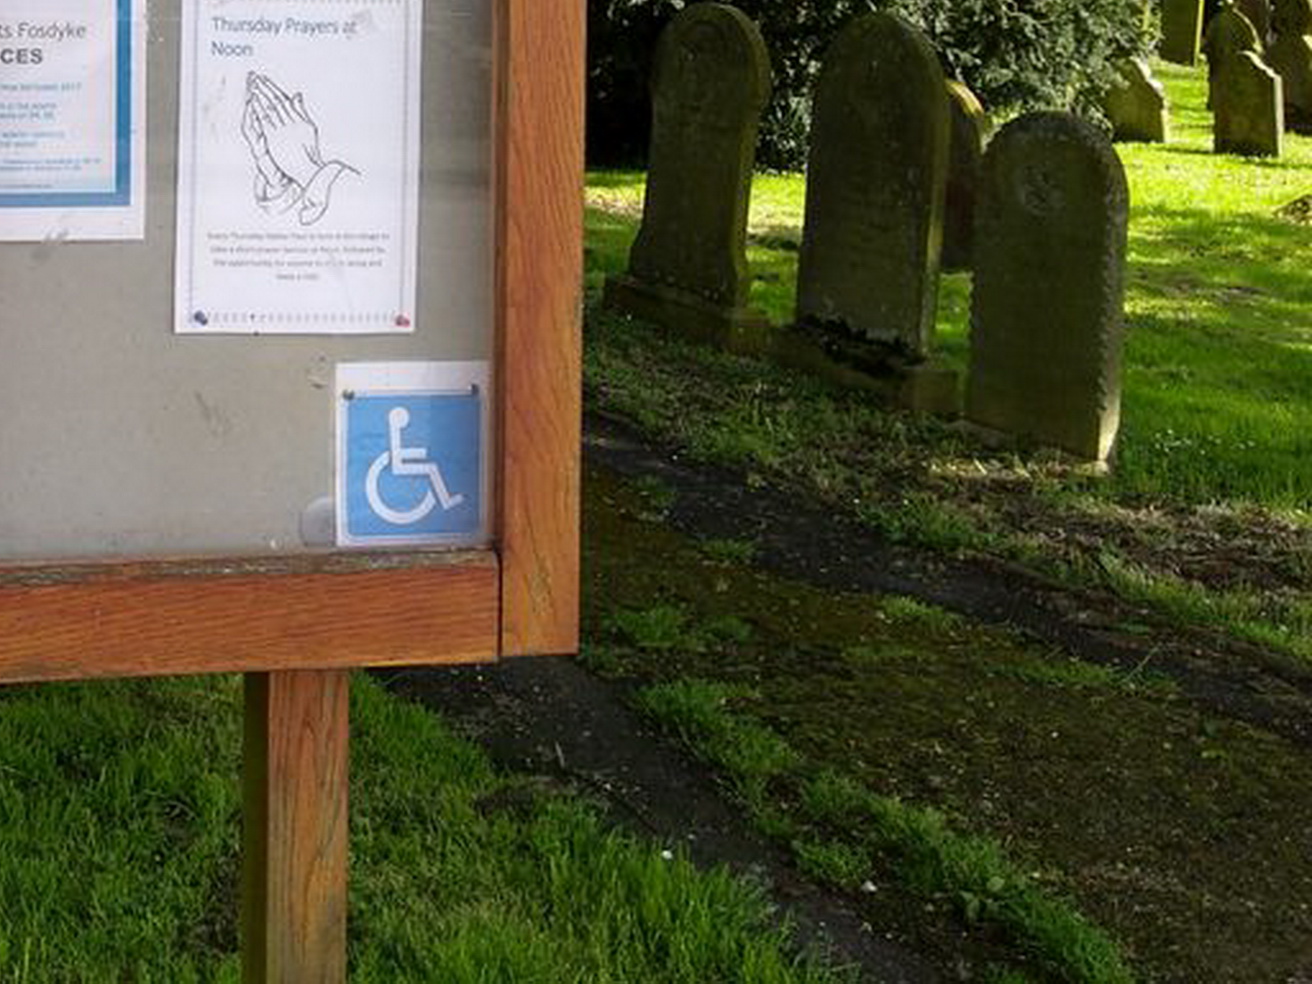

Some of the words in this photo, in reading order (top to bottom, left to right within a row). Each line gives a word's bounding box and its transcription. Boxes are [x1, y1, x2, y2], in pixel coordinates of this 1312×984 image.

[17, 22, 88, 42] Fosdyke
[211, 16, 282, 35] Thursday
[285, 17, 339, 36] Prayers
[210, 41, 254, 57] Noon
